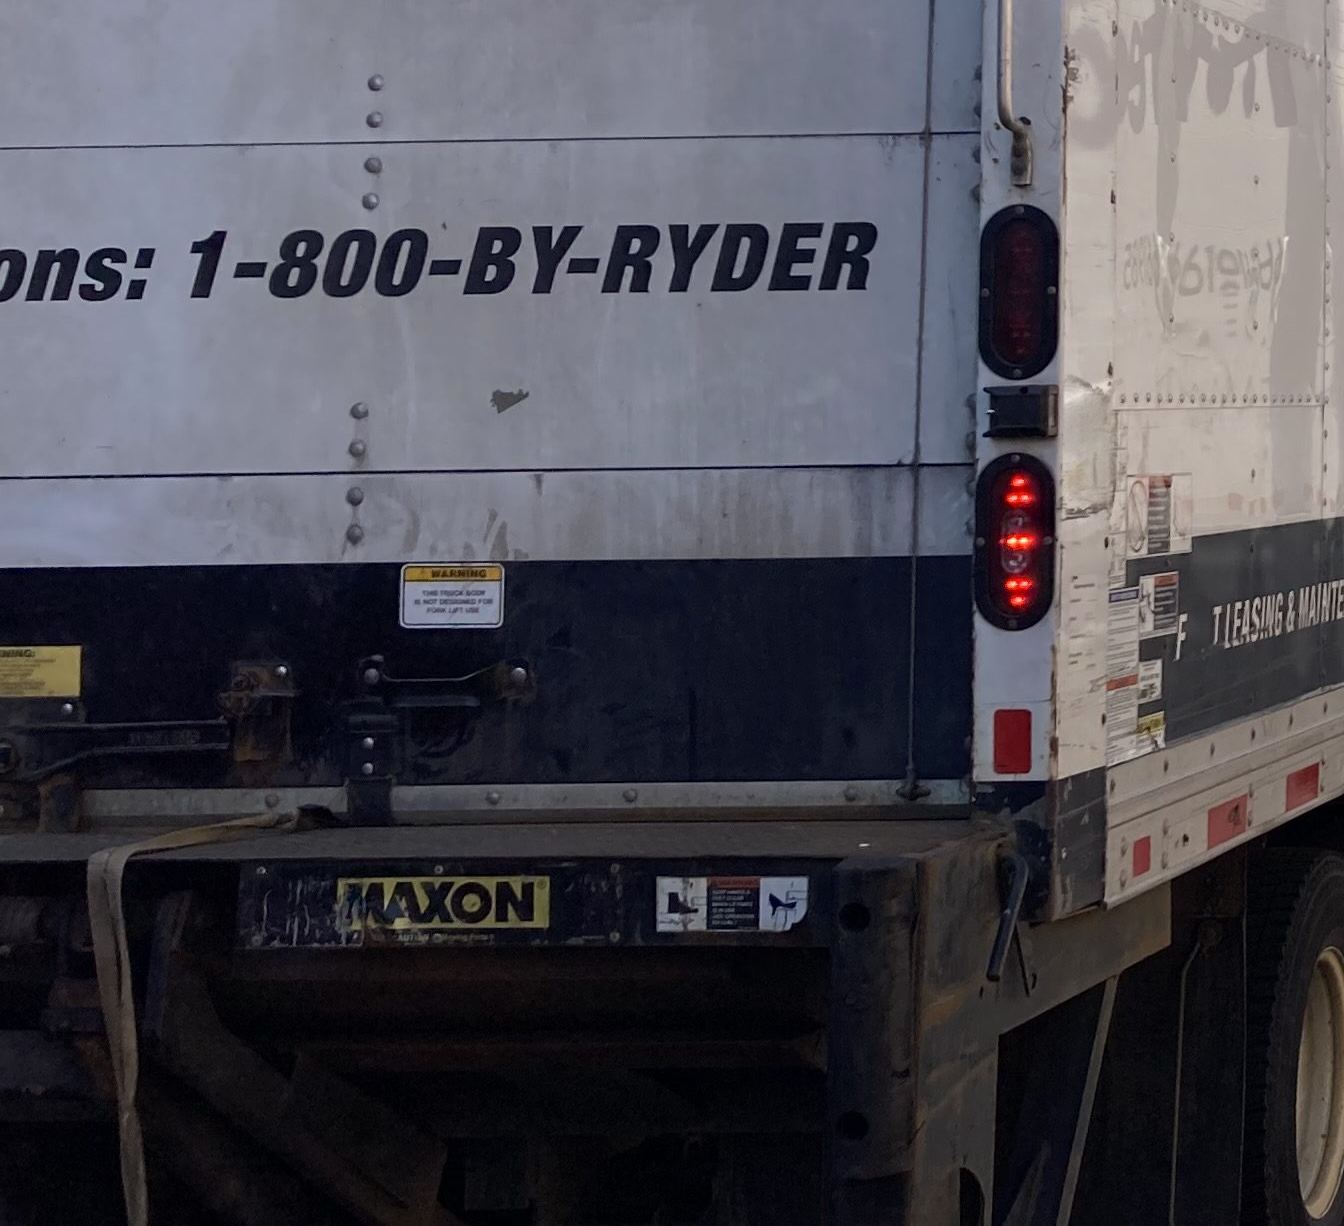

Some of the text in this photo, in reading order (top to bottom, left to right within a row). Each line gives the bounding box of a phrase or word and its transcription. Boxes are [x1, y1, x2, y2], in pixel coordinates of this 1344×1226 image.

[0, 221, 878, 302] ons: 1-800-BY-RYDER
[431, 569, 487, 578] WARNING
[1224, 592, 1284, 650] LEASING
[1286, 590, 1296, 633] &
[347, 881, 535, 924] MAXON
